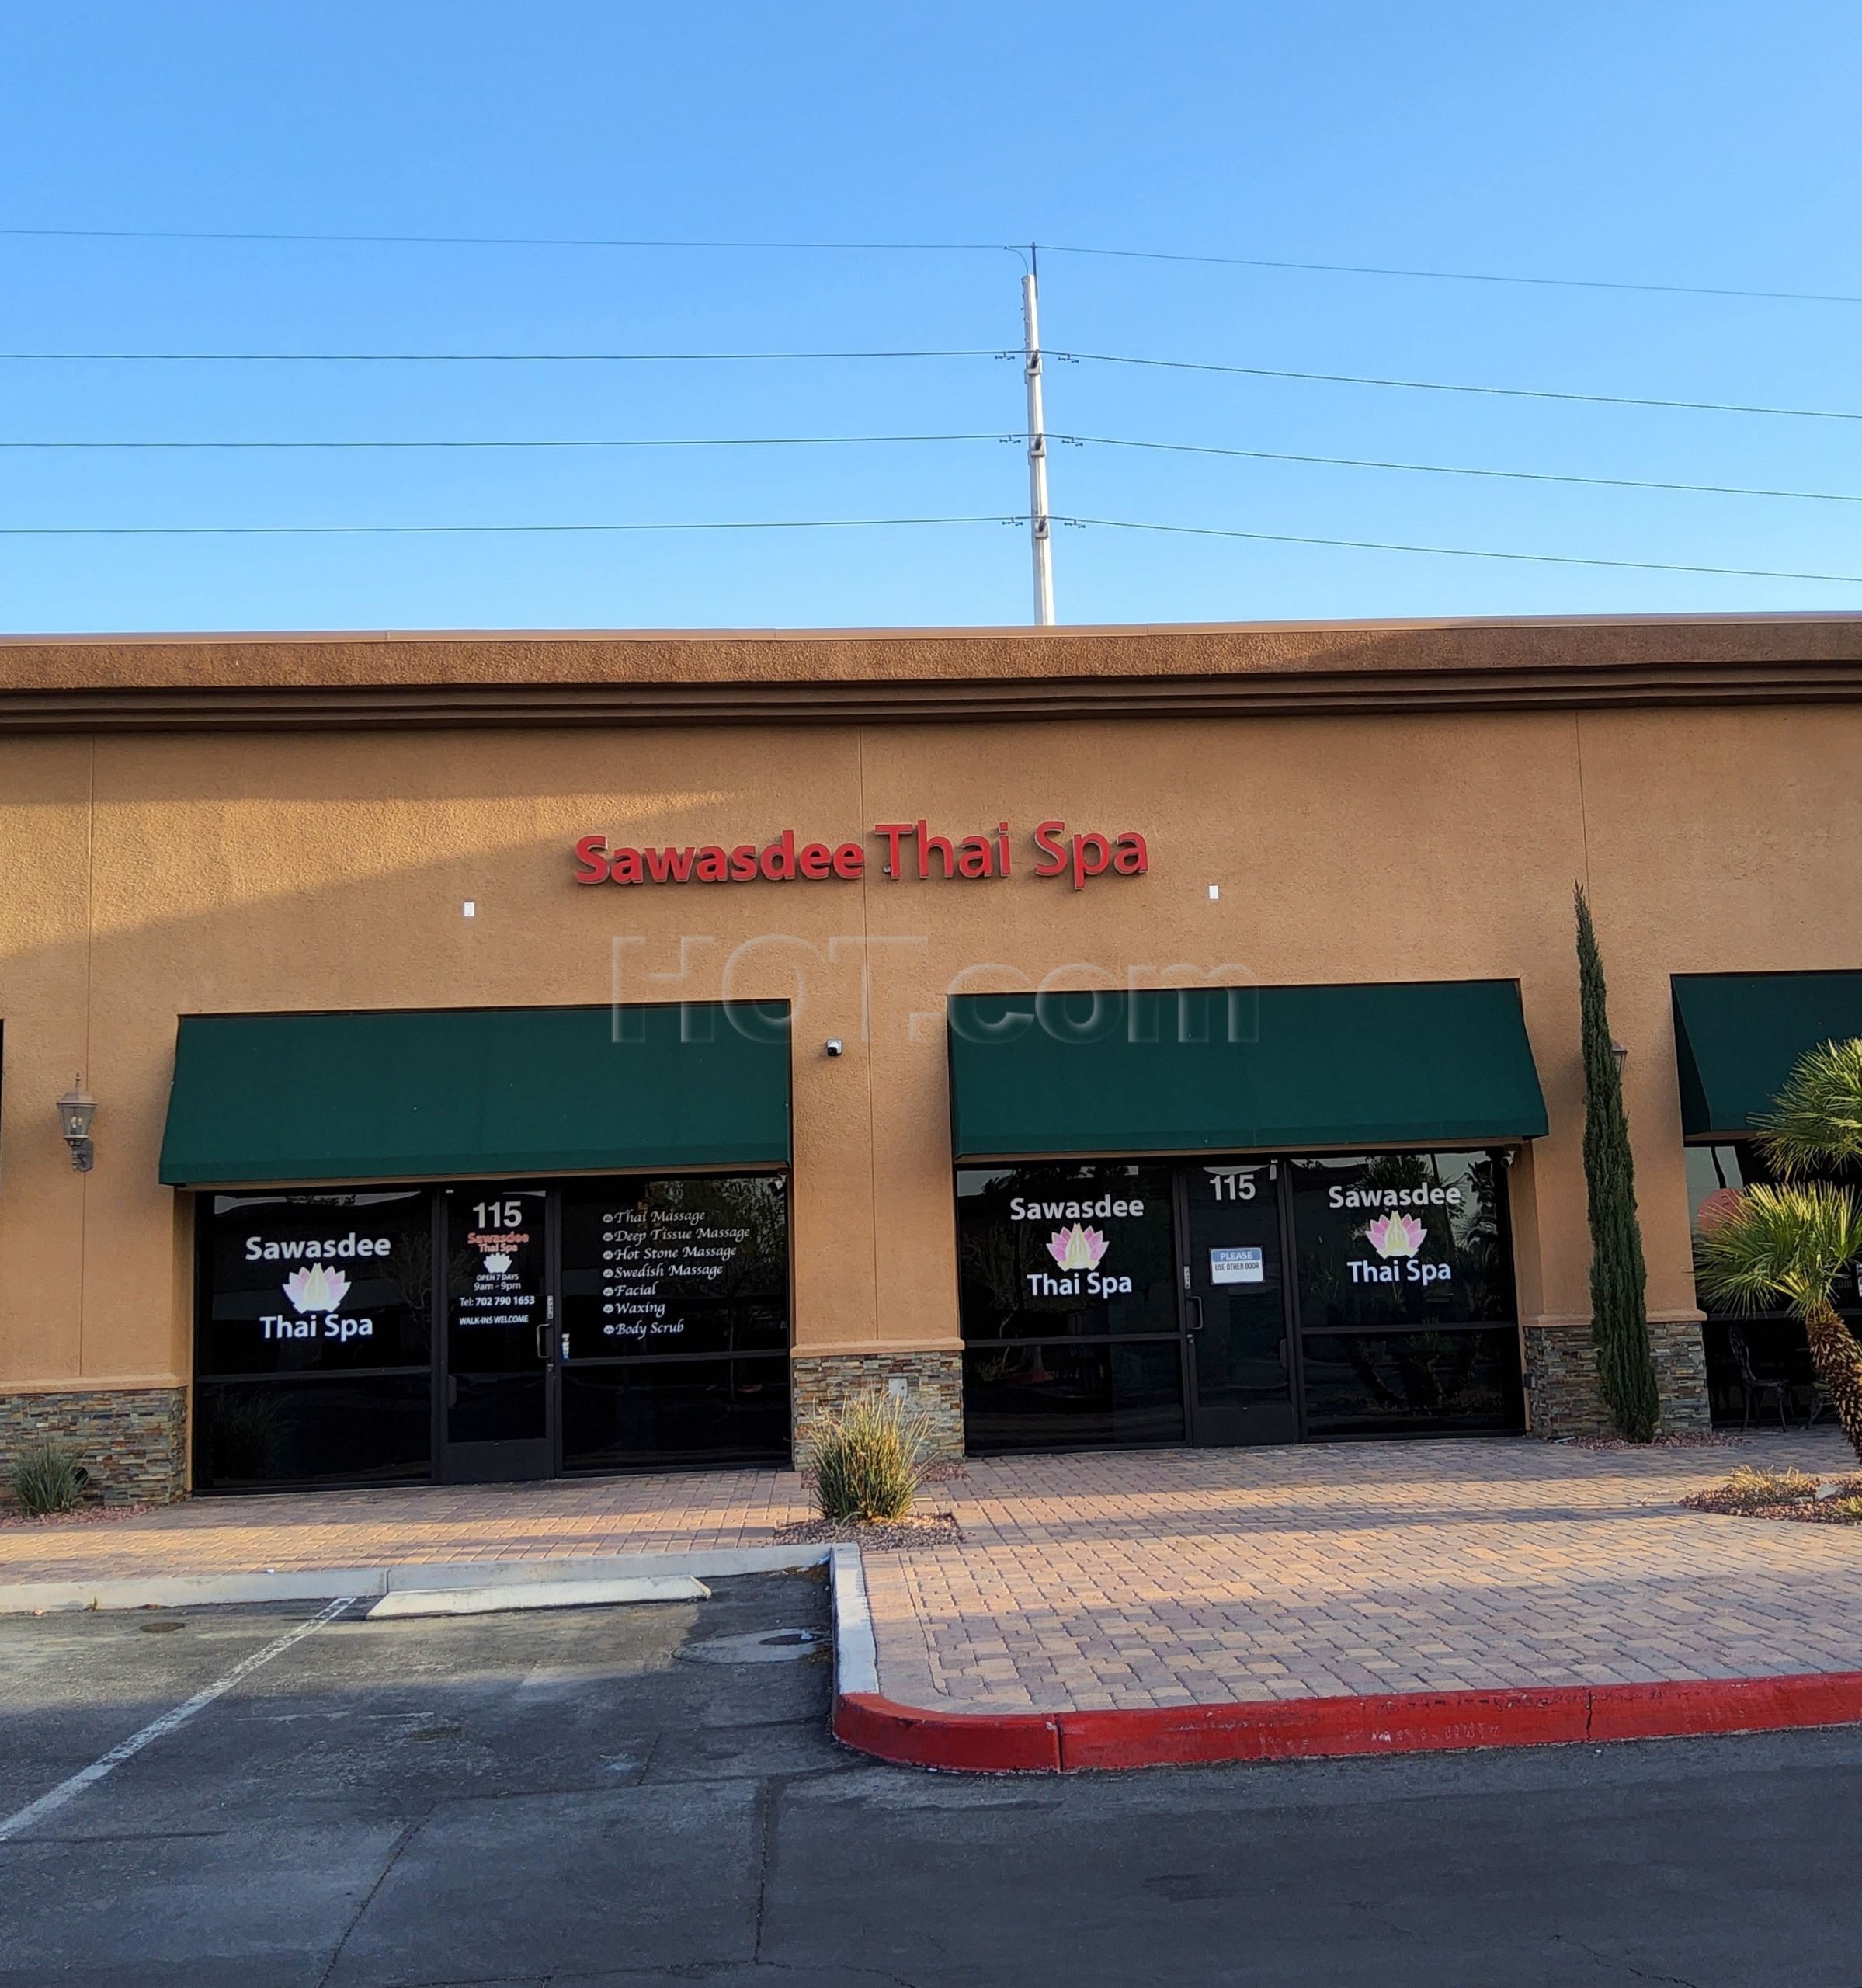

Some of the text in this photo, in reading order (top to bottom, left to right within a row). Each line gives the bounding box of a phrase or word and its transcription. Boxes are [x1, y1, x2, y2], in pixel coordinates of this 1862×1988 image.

[574, 819, 1149, 890] Sawasdee Thai Spa
[1210, 1174, 1256, 1200] 115
[1329, 1182, 1461, 1208] Sawasdee
[472, 1201, 522, 1229] 115
[1010, 1194, 1145, 1220] Sawasdee
[613, 1209, 706, 1225] Thai Massage
[467, 1231, 530, 1244] Sawasdee
[613, 1226, 750, 1246] Deep Tissue Massage
[245, 1232, 391, 1260] Sawasdee
[500, 1242, 518, 1253] Spa
[613, 1246, 737, 1261] Hot Stone Massage
[1220, 1251, 1252, 1260] PLEASE
[614, 1263, 723, 1280] Swedish Massage
[1347, 1259, 1451, 1286] Thai Spa
[474, 1282, 494, 1291] 9am
[500, 1281, 522, 1291] 9pm
[614, 1281, 660, 1297] Facial
[1027, 1272, 1132, 1298] Thai Spa
[460, 1295, 536, 1307] Tel: 702 790 1653
[615, 1302, 665, 1318] Waxing
[260, 1314, 373, 1341] Thai Spa
[494, 1315, 529, 1324] WELCOME
[616, 1319, 684, 1340] Body Scrub
